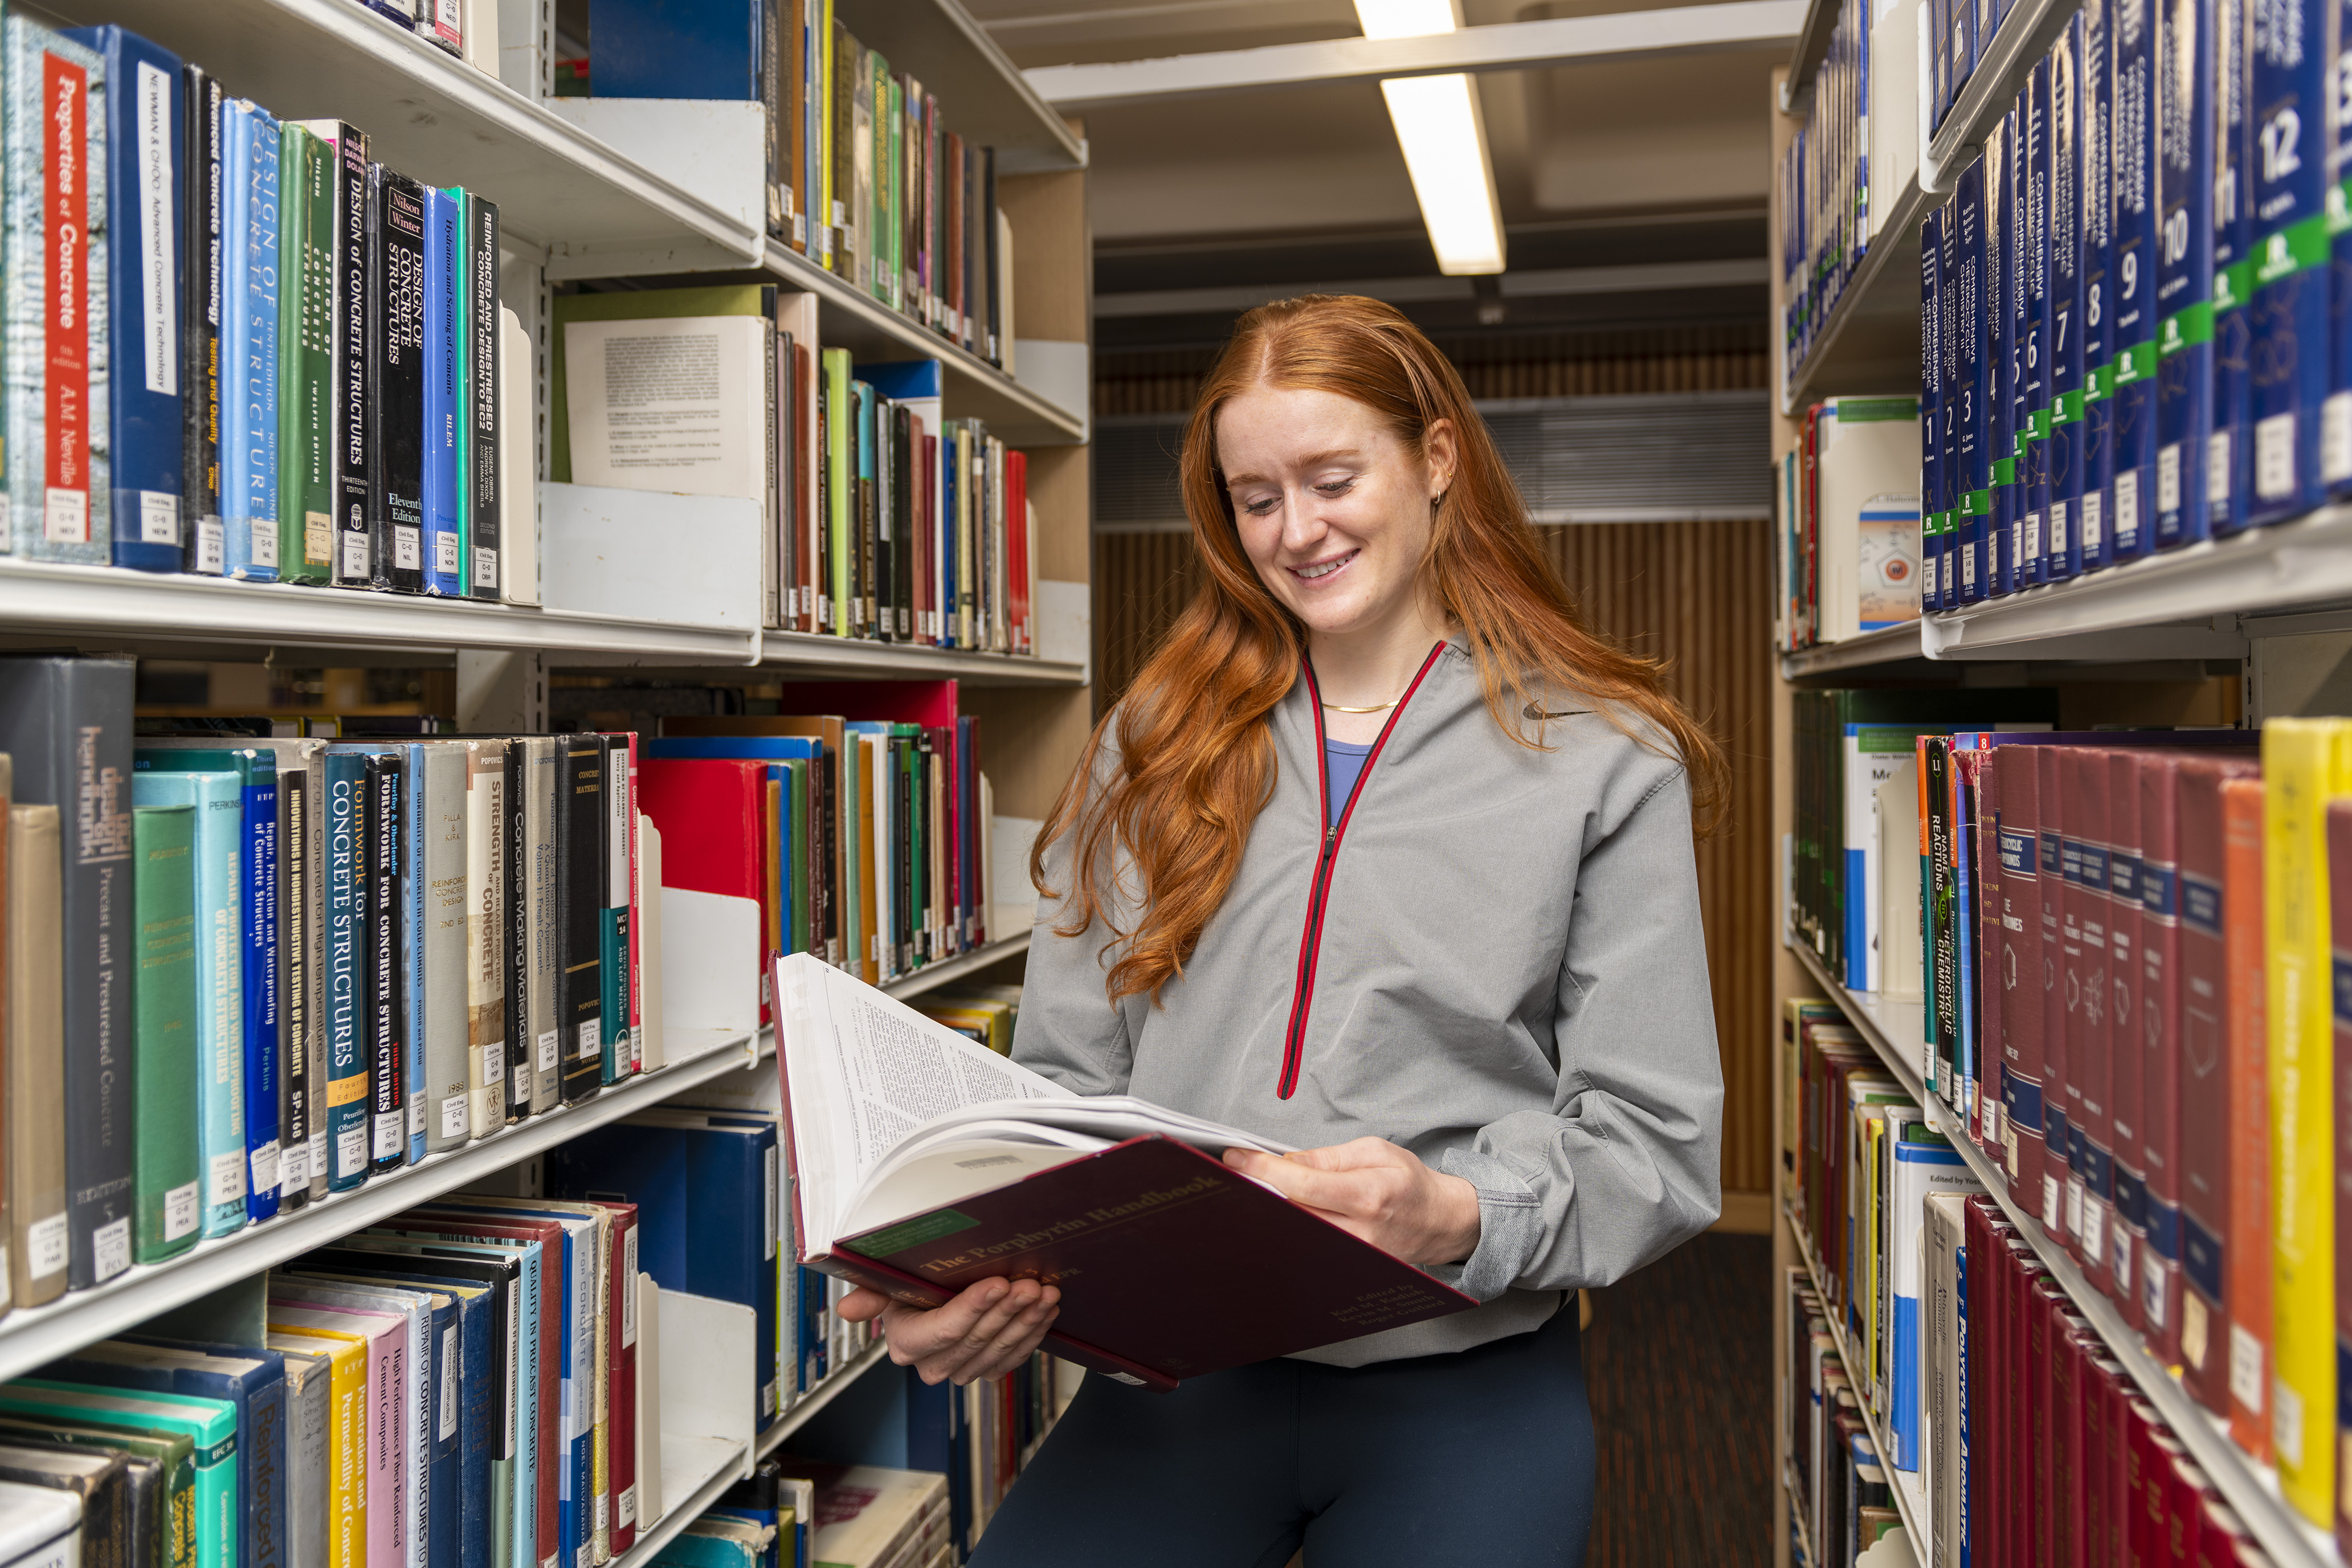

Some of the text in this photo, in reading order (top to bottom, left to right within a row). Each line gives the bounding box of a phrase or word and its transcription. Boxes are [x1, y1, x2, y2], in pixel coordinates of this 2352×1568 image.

[150, 73, 158, 133] NEWMAN
[2259, 107, 2302, 183] 12
[151, 150, 161, 193] CHOO:
[346, 160, 365, 176] DOLAN
[55, 74, 78, 329] Properties of Concrete
[208, 81, 220, 326] Advanced Concrete Technology
[249, 118, 264, 297] CONCRETE
[263, 125, 278, 308] DESIGN OF
[391, 211, 421, 234] Winter
[392, 195, 420, 217] Nilson
[153, 197, 161, 256] Advanced
[2164, 209, 2188, 266] 10
[154, 260, 164, 315] Concrete
[401, 248, 411, 347] CONCRETE
[2122, 251, 2137, 300] 9
[350, 178, 363, 466] DESIGN of CONCRETE STRUCTURES
[389, 242, 399, 365] STRUCTURES
[413, 252, 423, 349] DESIGN OF
[2088, 283, 2101, 327] 8
[156, 319, 165, 387] Technology
[324, 334, 331, 356] OF
[2028, 330, 2037, 369] 6
[2057, 311, 2068, 352] 7
[209, 337, 218, 376] Testing
[479, 380, 485, 400] TO
[1964, 390, 1971, 422] 3
[1990, 368, 1996, 401] 4
[208, 404, 220, 444] Quality
[1926, 416, 1932, 444] 1
[1946, 406, 1953, 436] 2
[60, 428, 77, 485] Neville
[342, 475, 369, 487] THIRTEENTH
[346, 485, 366, 495] EDITION
[389, 492, 423, 511] Eleventh
[1965, 495, 1970, 508] R
[392, 507, 422, 524] Edition
[255, 755, 273, 763] Third
[481, 756, 503, 765] POPOVICS
[1981, 738, 1987, 749] 8
[252, 764, 276, 773] edition
[210, 799, 240, 812] PERKINS
[390, 773, 399, 810] Peurifoy
[446, 833, 460, 842] KIRK
[492, 781, 501, 872] STRENGTH
[354, 779, 366, 921] Formwork for
[1933, 815, 1943, 892] REACTIONS
[255, 823, 266, 948] of Concrete Structures
[265, 822, 276, 1025] Repair, Protection and Waterproofing
[291, 790, 302, 1077] INNOVATIONS IN NONDESTRUCTIVE TESTING OF CONCRETE
[333, 780, 353, 1067] CONCRETE STRUCTURES
[483, 887, 493, 983] CONCRETE
[515, 812, 528, 1048] Concrete-Making Materials
[617, 914, 627, 924] MCT
[619, 926, 626, 934] 14
[100, 867, 113, 1065] Precast and Prestressed
[379, 774, 391, 1113] FORMWORK FOR CONCRETE STRUCTURES
[1944, 929, 1953, 1035] HETEROCYCLIC
[215, 928, 228, 1084] CONCRETE STRUCTURES
[263, 1047, 271, 1092] Perkins
[292, 1090, 303, 1138] SP-168
[488, 1115, 501, 1126] WILEY
[1930, 1175, 1963, 1186] Edited by
[920, 1253, 971, 1274] The
[966, 1219, 1088, 1260] Porphyrin
[1084, 1175, 1224, 1223] Handbook
[1329, 1289, 1425, 1317] Karl Kadish
[1337, 1294, 1436, 1323] Kevin Smith
[1356, 1283, 1414, 1302] Edited by
[529, 1321, 537, 1335] IN
[1357, 1314, 1395, 1326] Roger
[379, 1355, 389, 1471] Cement Composites
[419, 1315, 430, 1542] REPAIR OF CONCRETE STRUCTURES
[211, 1439, 234, 1460] EFC 38
[340, 1391, 353, 1491] Permeability
[357, 1384, 368, 1509] Penetration and
[393, 1348, 402, 1549] High Performance Fiber Reinforced
[1959, 1436, 1968, 1547] AROMATIC
